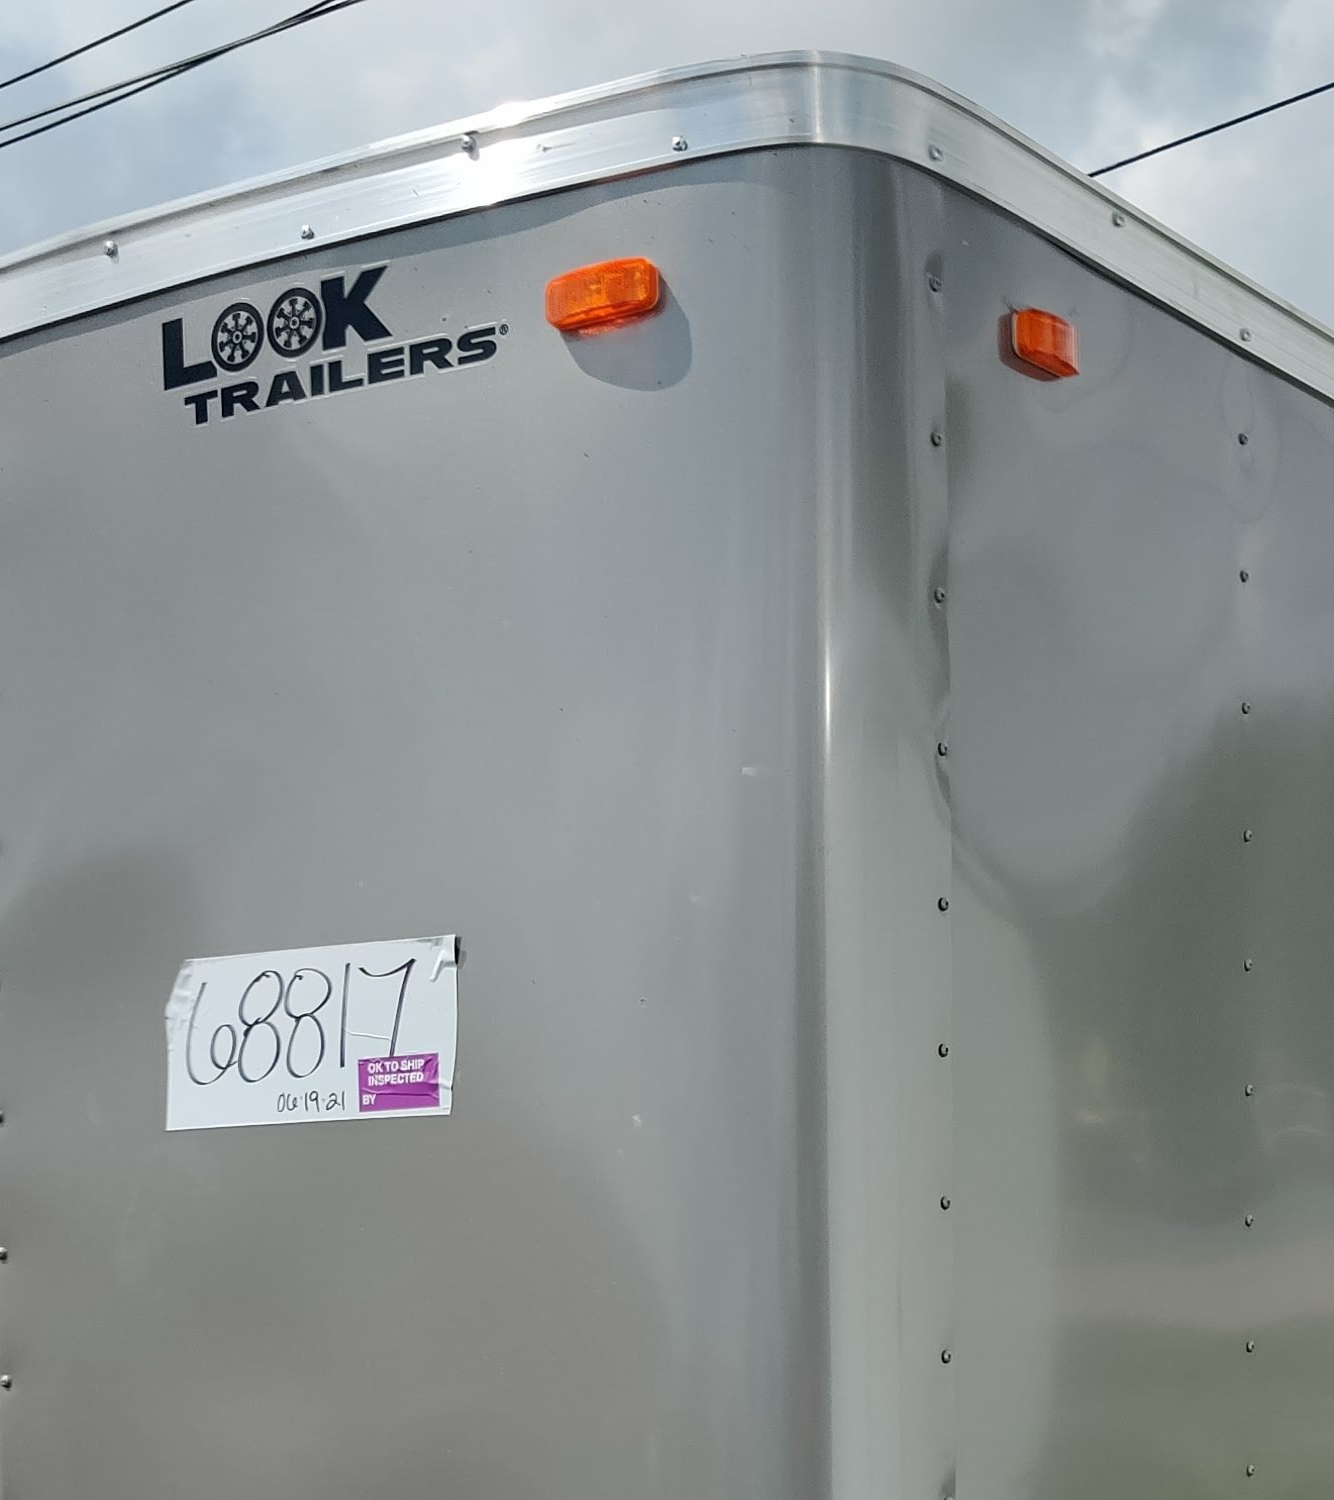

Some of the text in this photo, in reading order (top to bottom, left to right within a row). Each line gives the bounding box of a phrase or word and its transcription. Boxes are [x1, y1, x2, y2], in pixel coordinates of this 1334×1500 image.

[161, 264, 393, 391] LOOK
[185, 958, 417, 1086] 68817
[367, 1058, 425, 1074] OK TO SHIP
[367, 1071, 425, 1087] INSPECTED
[362, 1093, 377, 1106] BY
